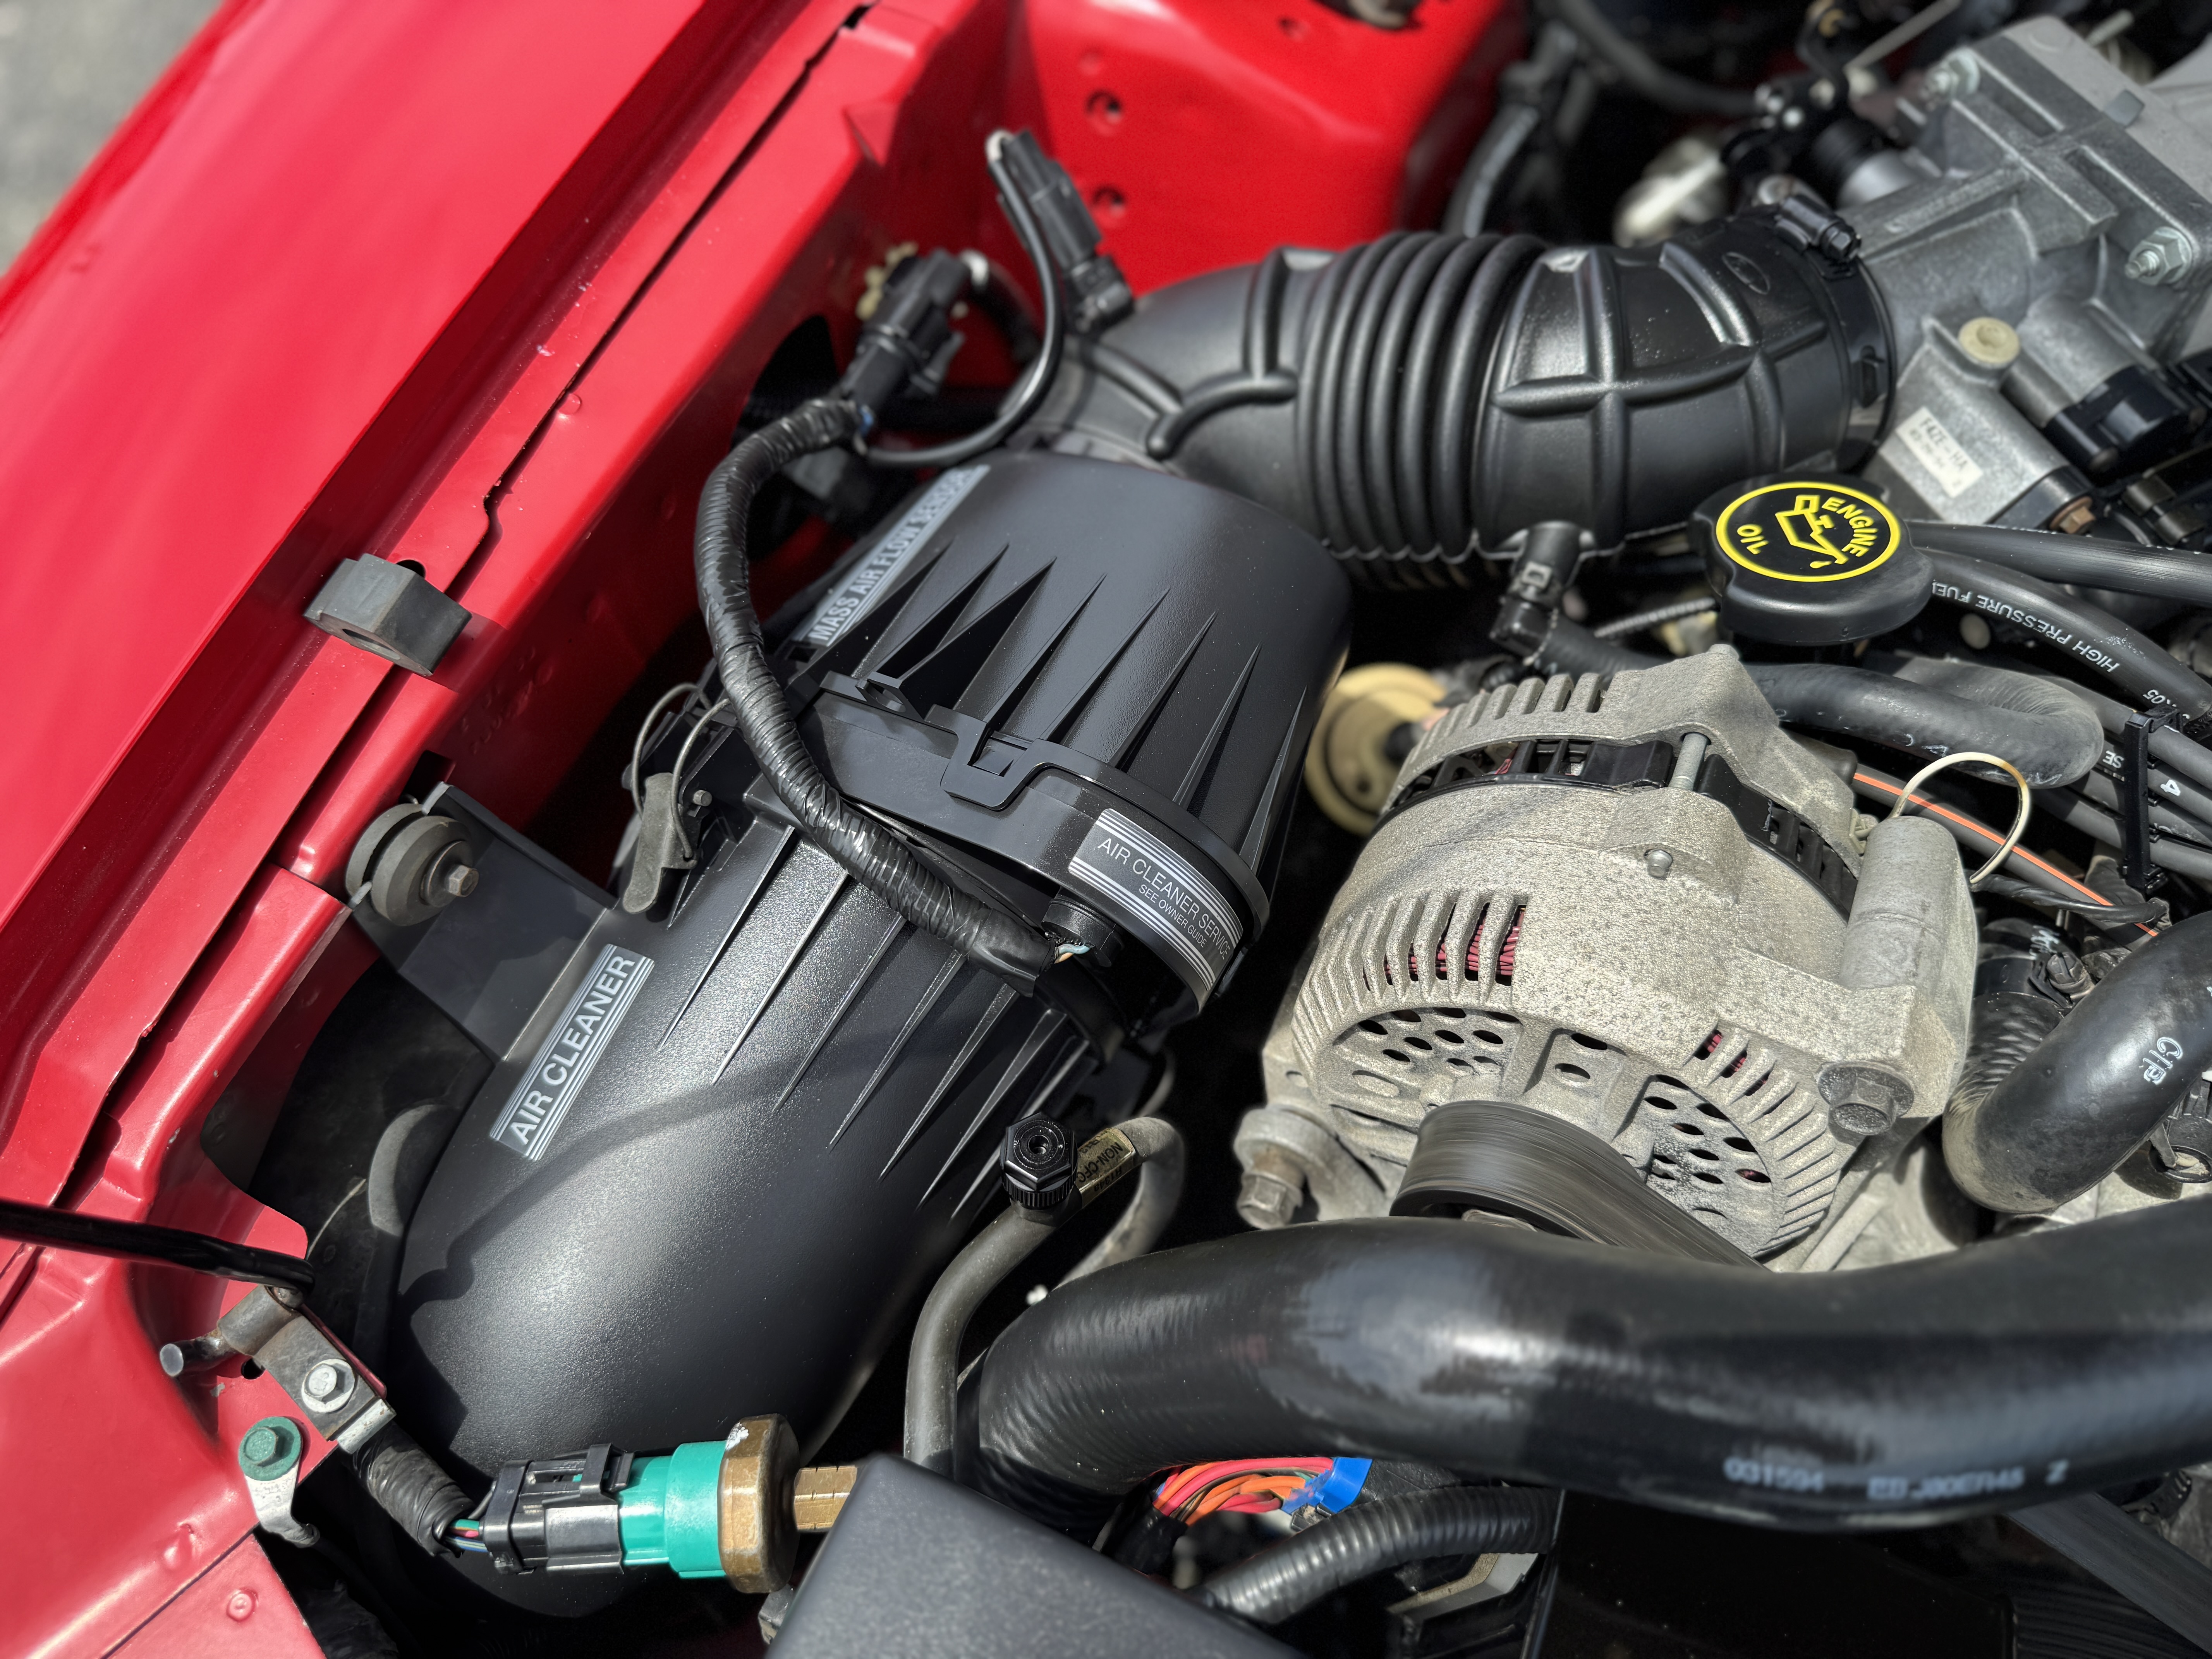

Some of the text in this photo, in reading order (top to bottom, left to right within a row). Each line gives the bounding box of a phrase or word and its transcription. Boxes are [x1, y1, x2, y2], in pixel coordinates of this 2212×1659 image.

[1737, 524, 1769, 555] OIL
[1821, 496, 1878, 557] ENGINE
[808, 597, 859, 641] MASS
[850, 567, 885, 594] AIR
[874, 522, 922, 567] FLOW
[1975, 594, 2073, 645] PRESSURE
[2072, 640, 2120, 673] HIGH
[1097, 838, 1230, 960] AIR CLEANER SERVICE
[1139, 884, 1207, 948] SEE OWNER GUIDE
[510, 956, 635, 1145] AIR CLEANER
